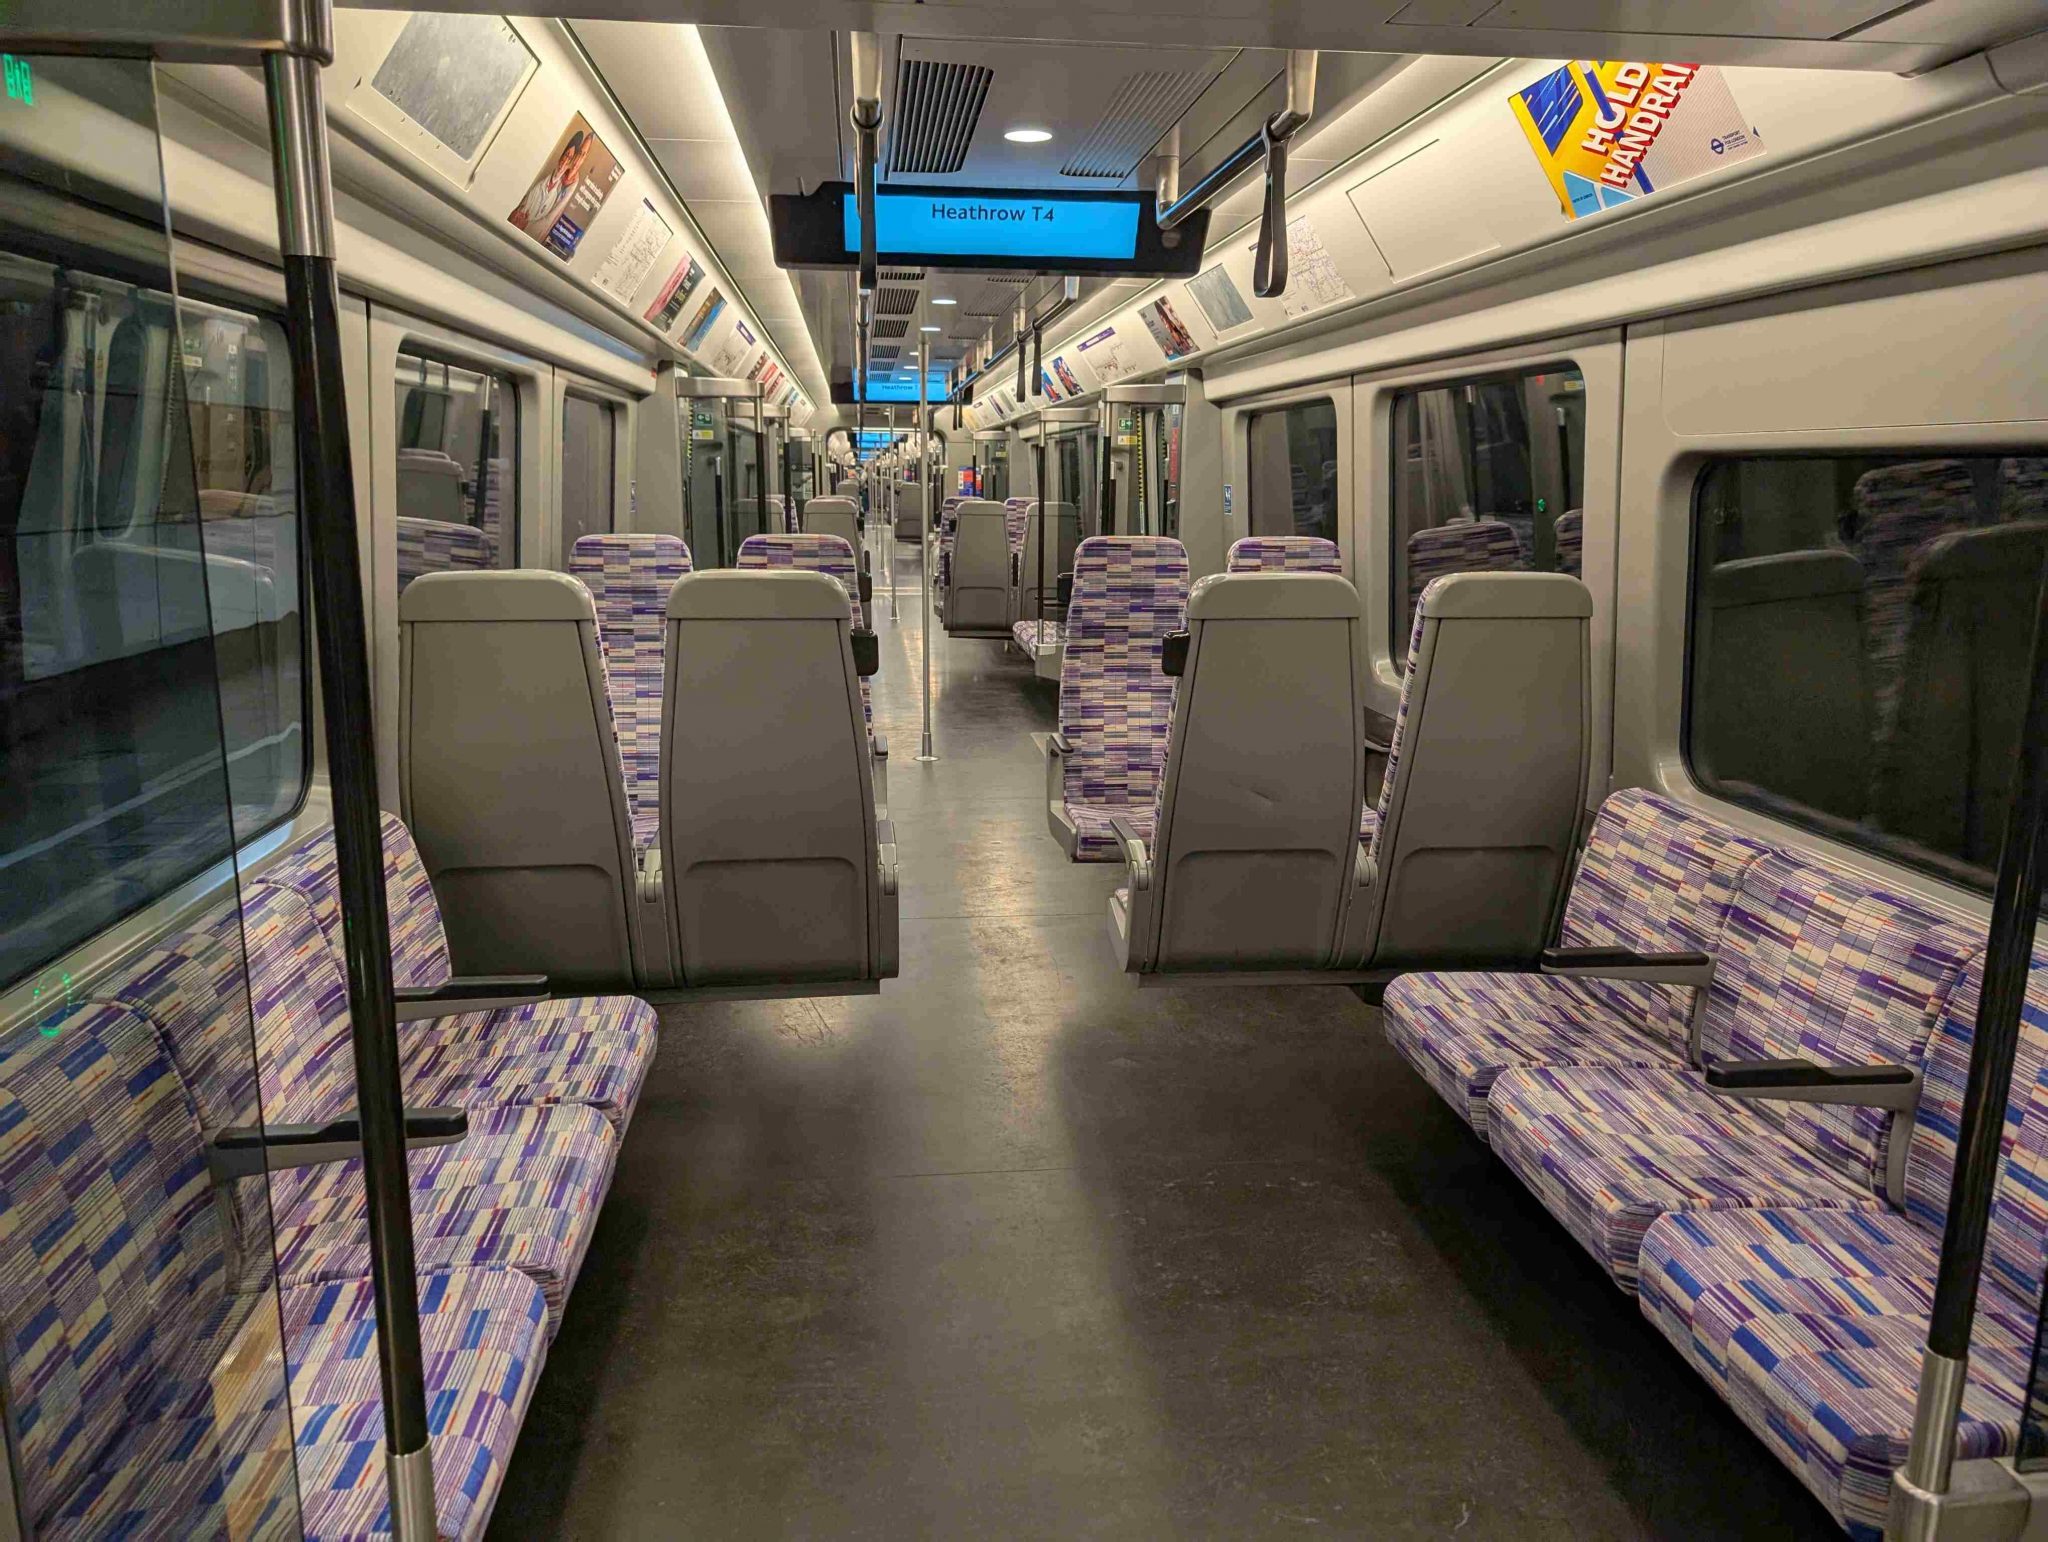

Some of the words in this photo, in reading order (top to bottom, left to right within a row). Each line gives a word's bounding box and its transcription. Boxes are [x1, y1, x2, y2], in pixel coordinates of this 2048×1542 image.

[1581, 62, 1650, 155] HOLD
[1600, 62, 1697, 187] HANDRAI
[931, 203, 1026, 221] Heathrow
[1032, 206, 1055, 222] T4
